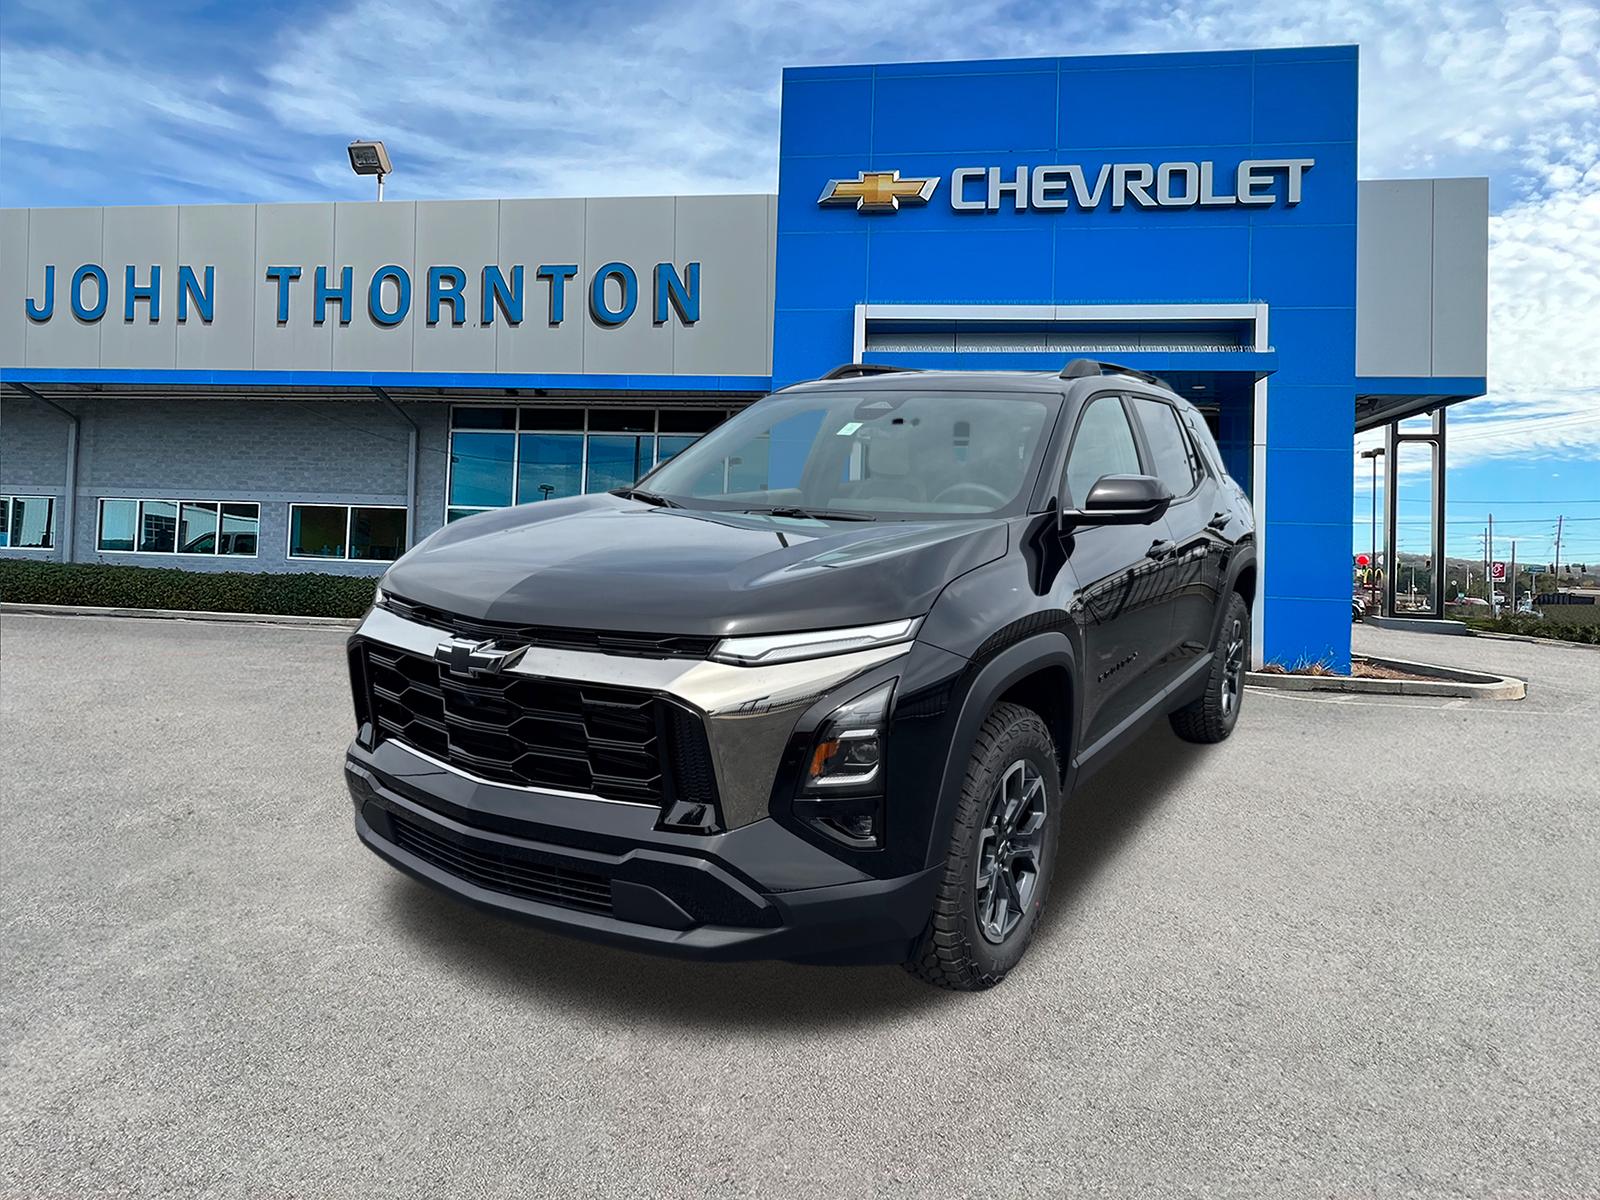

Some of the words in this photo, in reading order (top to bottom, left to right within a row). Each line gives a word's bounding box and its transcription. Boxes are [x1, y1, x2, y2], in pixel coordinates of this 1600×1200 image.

[950, 158, 1316, 212] CHEVROLET
[25, 264, 214, 323] JOHN
[266, 261, 702, 327] THORNTON
